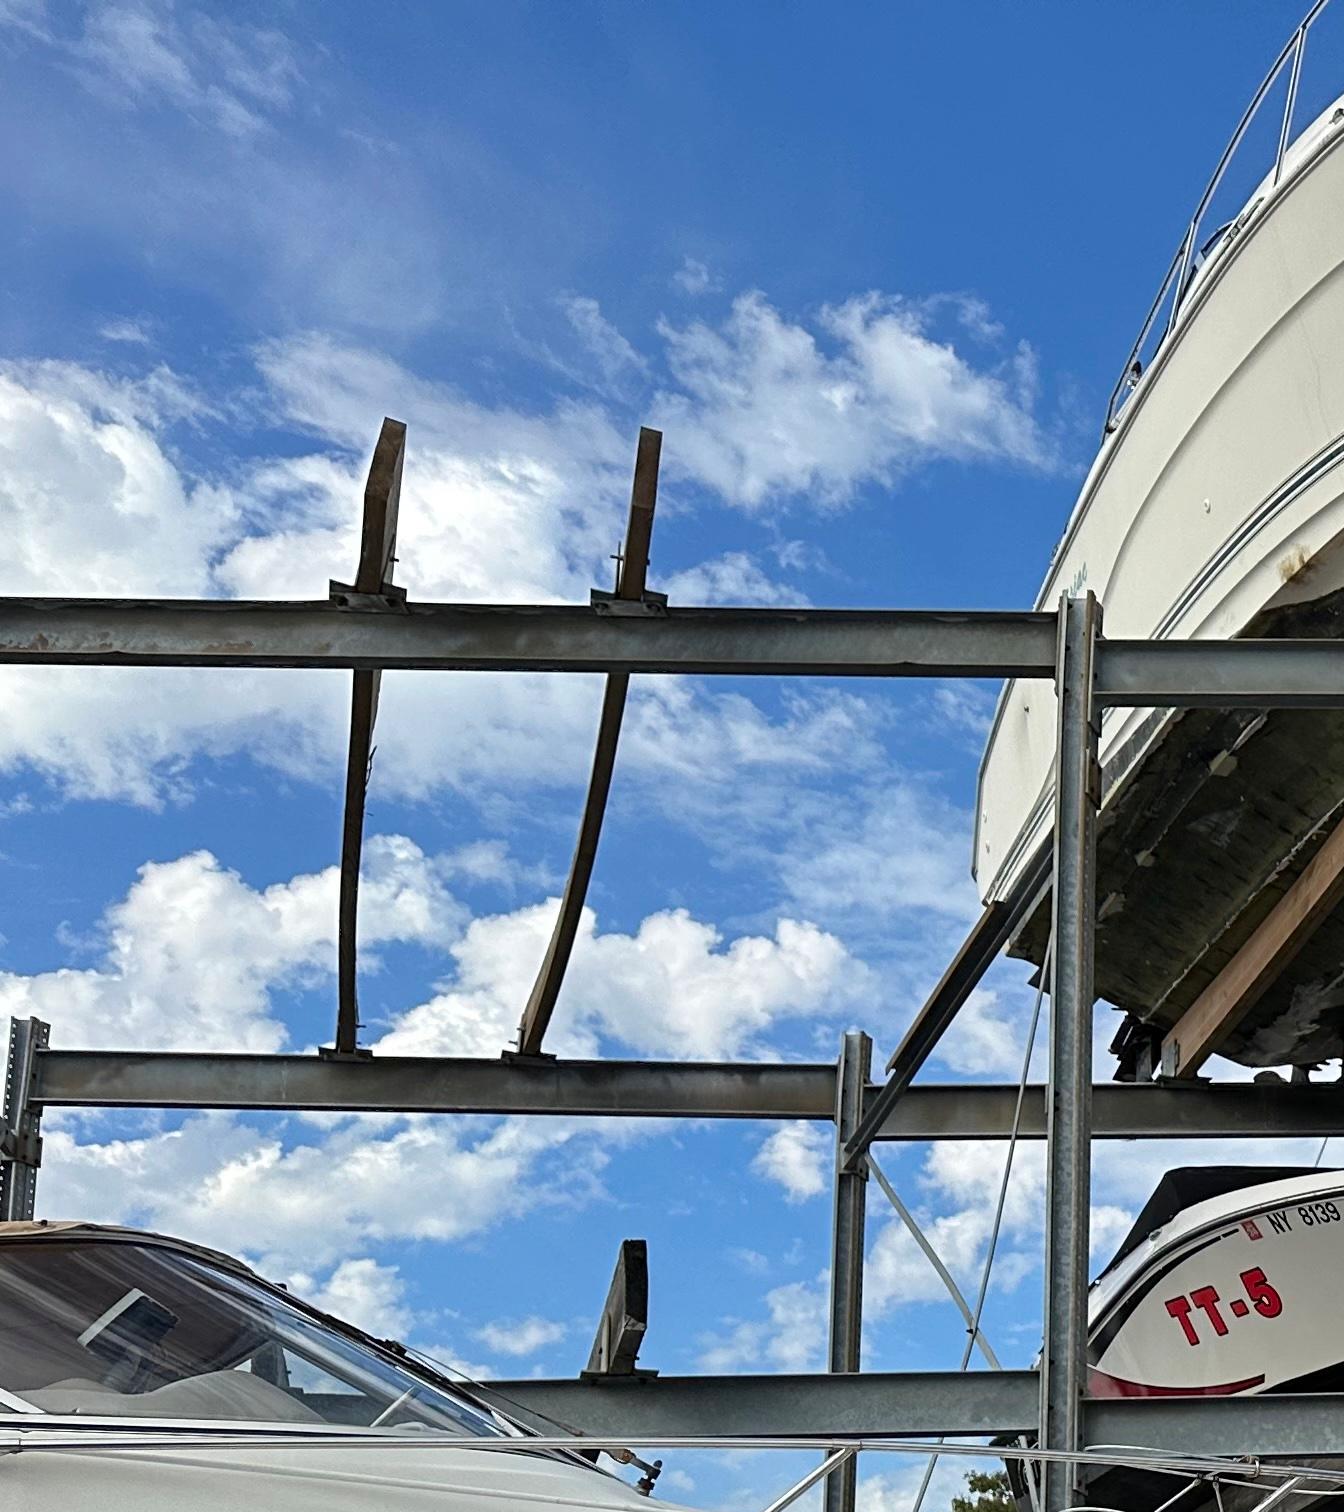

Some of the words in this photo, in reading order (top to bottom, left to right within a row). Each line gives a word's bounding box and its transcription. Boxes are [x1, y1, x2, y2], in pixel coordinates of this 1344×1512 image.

[1266, 1210, 1293, 1234] NY
[1298, 1201, 1341, 1226] 8139
[1164, 1266, 1283, 1347] TT-5
